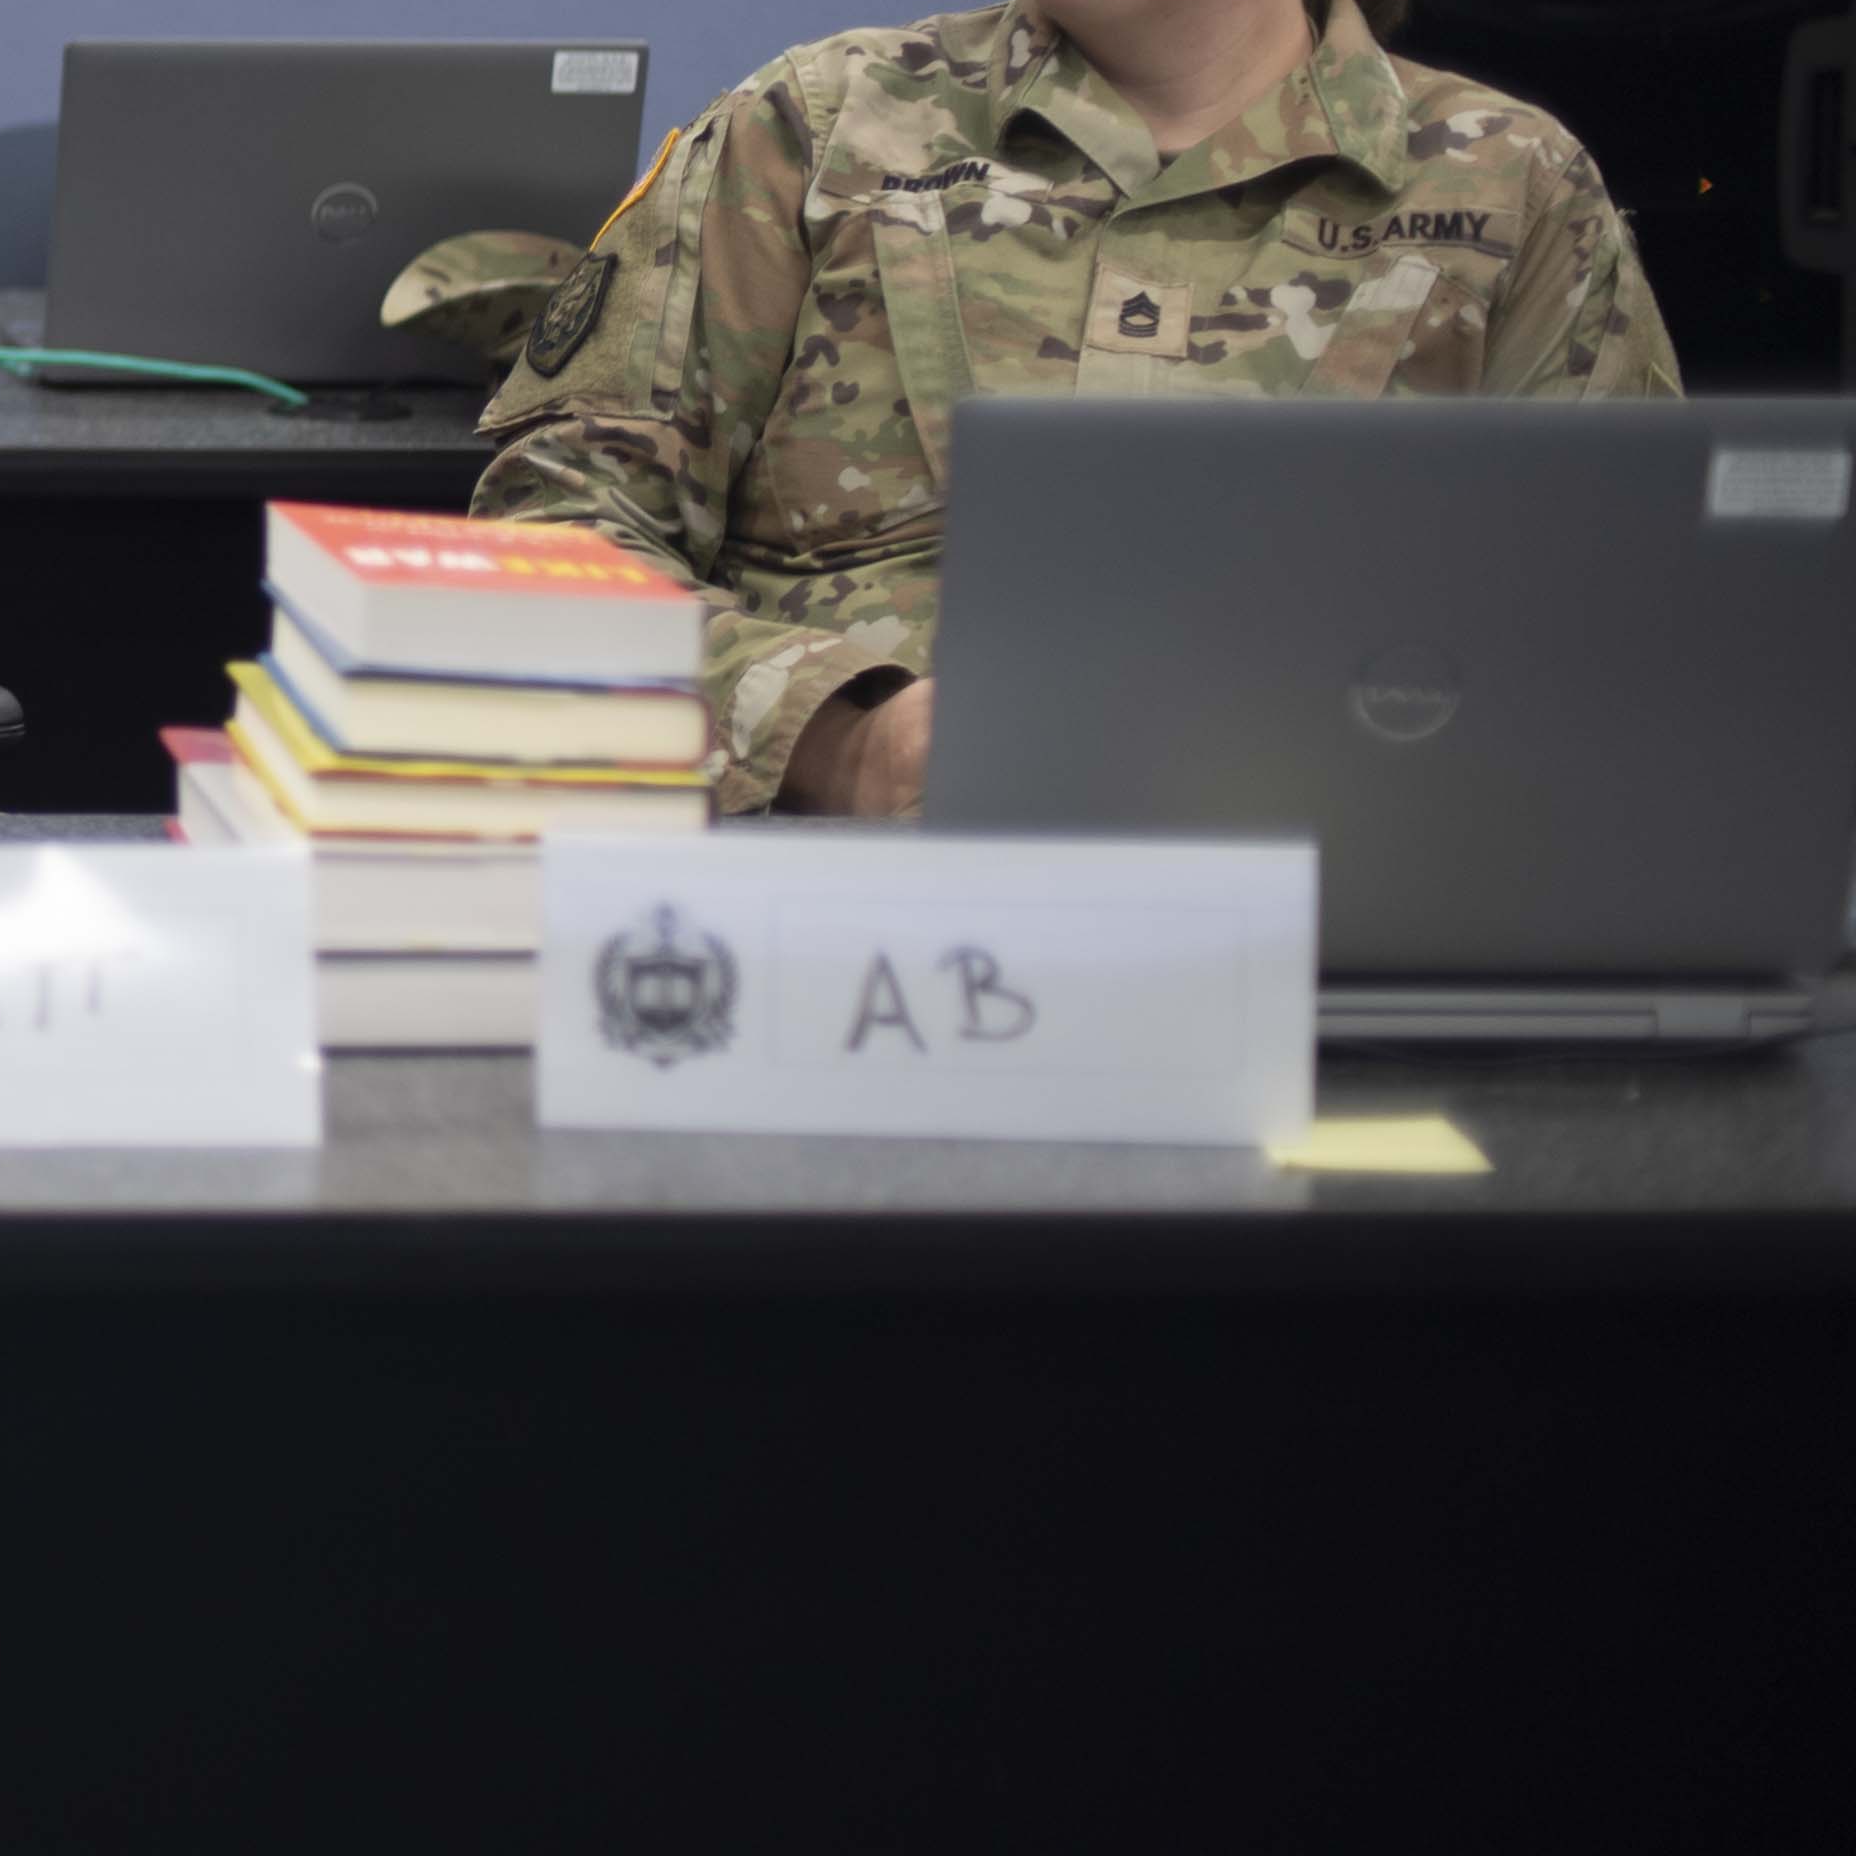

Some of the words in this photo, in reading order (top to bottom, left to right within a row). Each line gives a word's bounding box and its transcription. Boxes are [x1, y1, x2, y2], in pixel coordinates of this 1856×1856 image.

[1317, 217, 1379, 252] U.S.
[1382, 210, 1490, 242] ARMY
[845, 944, 1038, 1056] AB
